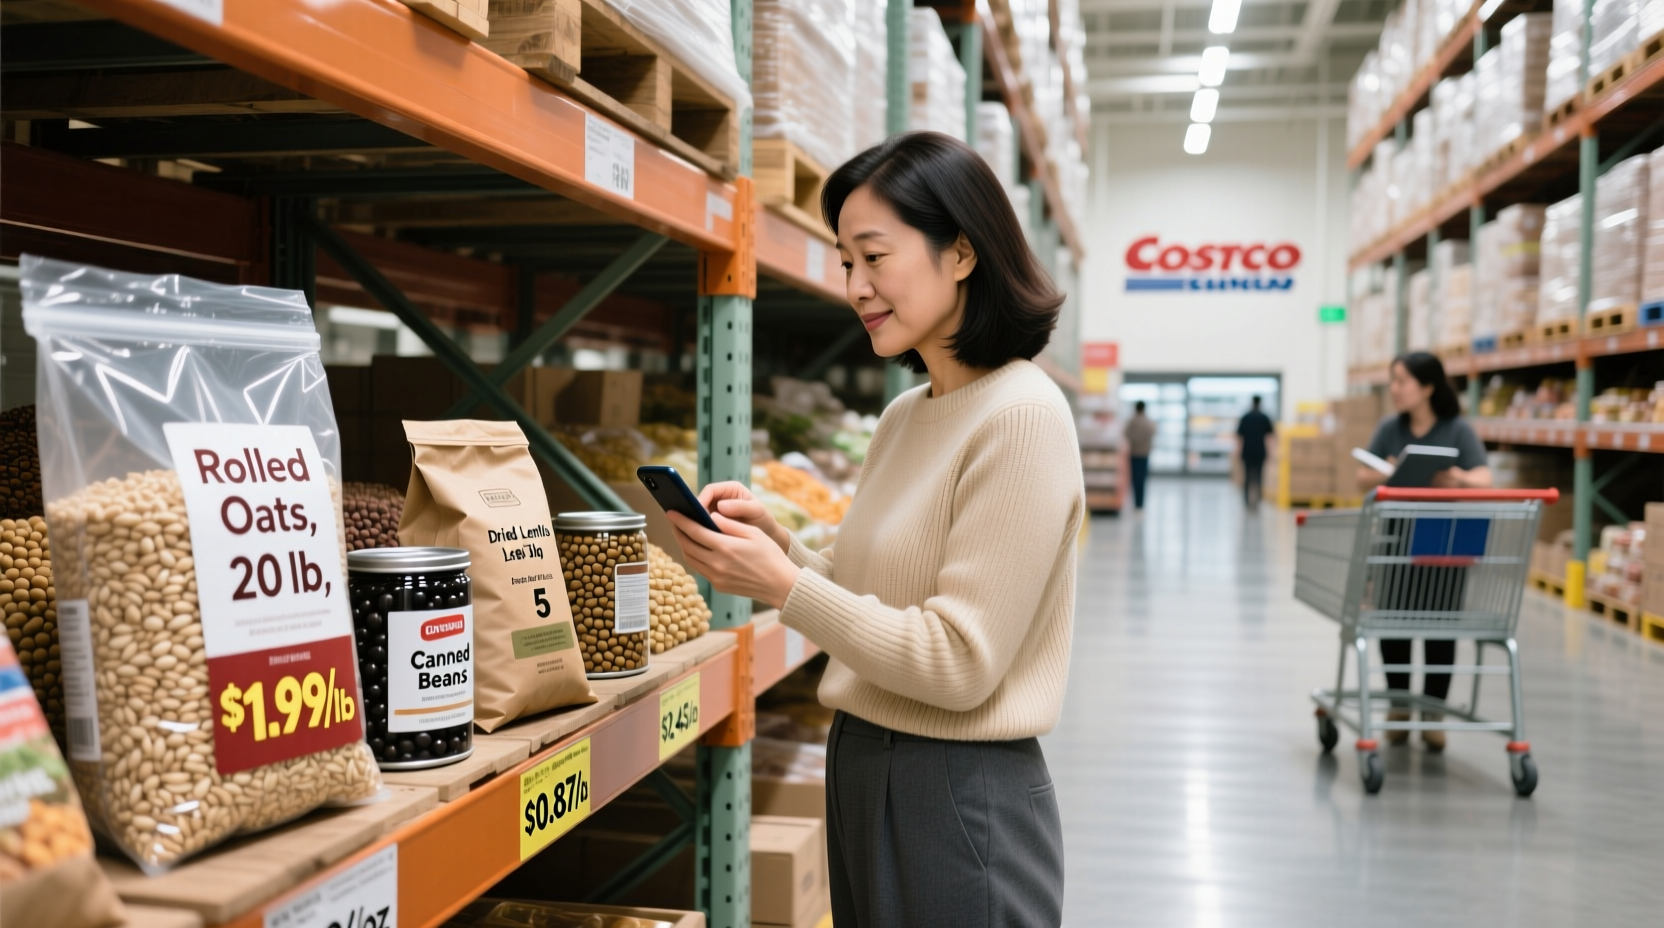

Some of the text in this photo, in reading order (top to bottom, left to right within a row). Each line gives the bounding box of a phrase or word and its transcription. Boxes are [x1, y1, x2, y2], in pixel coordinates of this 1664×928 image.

[193, 447, 311, 484] Rolled
[220, 495, 318, 537] Oats,
[229, 551, 332, 601] 20 lb,
[533, 587, 551, 618] 5
[410, 641, 470, 670] Canned
[418, 669, 468, 690] Beans
[219, 668, 356, 742] $1.99/lb
